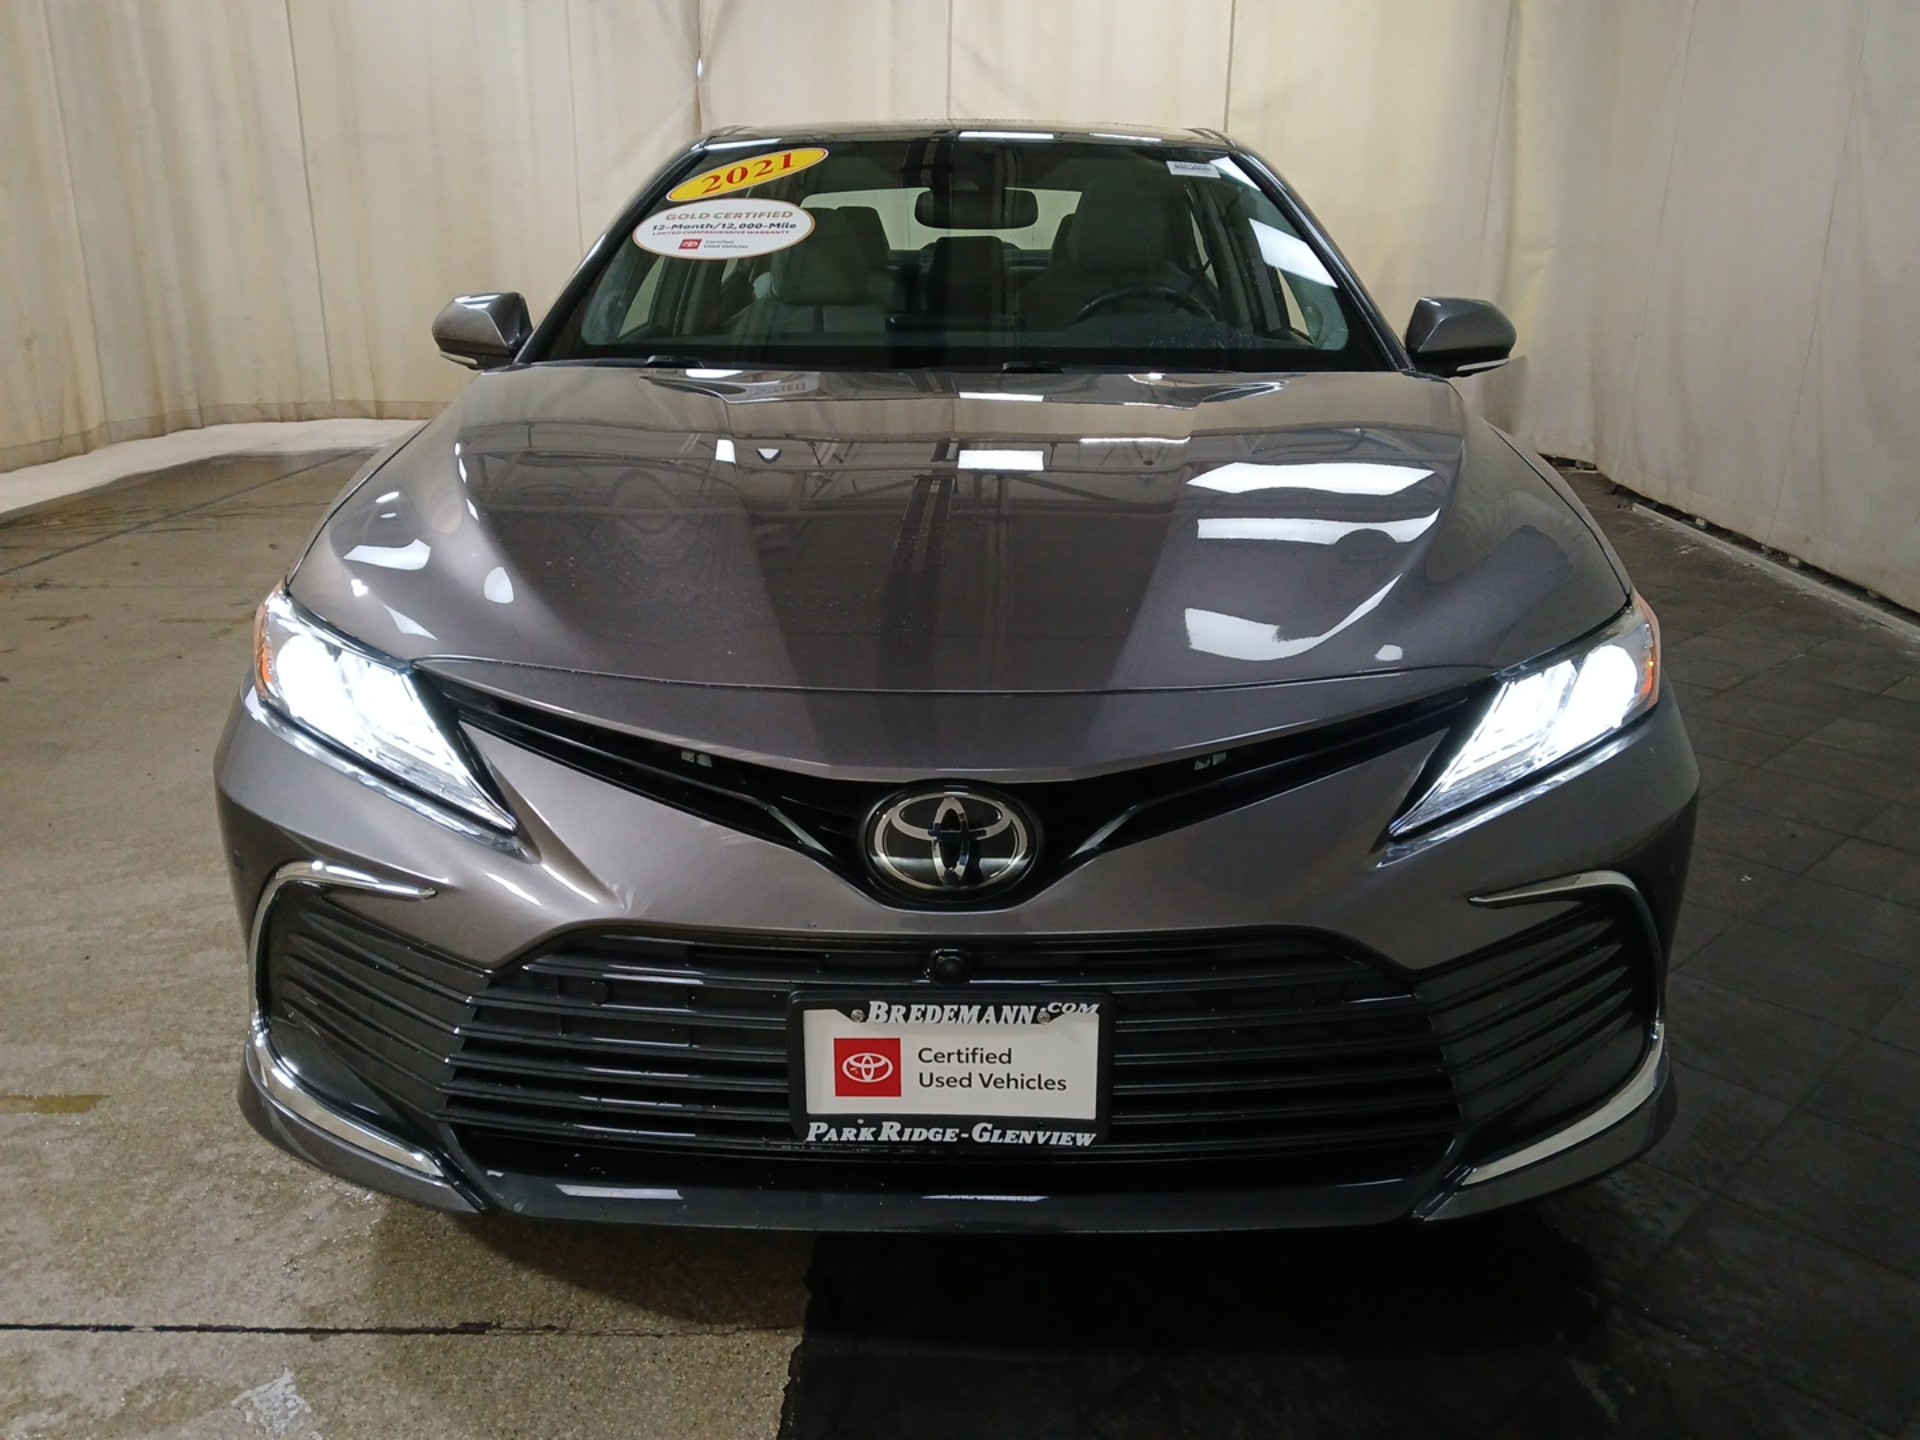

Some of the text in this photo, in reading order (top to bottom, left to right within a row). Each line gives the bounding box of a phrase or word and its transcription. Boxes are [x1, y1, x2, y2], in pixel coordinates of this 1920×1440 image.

[701, 153, 795, 194] 2021
[665, 210, 794, 221] GOLD CERTIFIED
[652, 221, 797, 231] 12-Month/12,000-Mile
[918, 1047, 1013, 1065] Certified
[919, 1071, 1067, 1091] Used Vehicles
[806, 1121, 876, 1142] PARK
